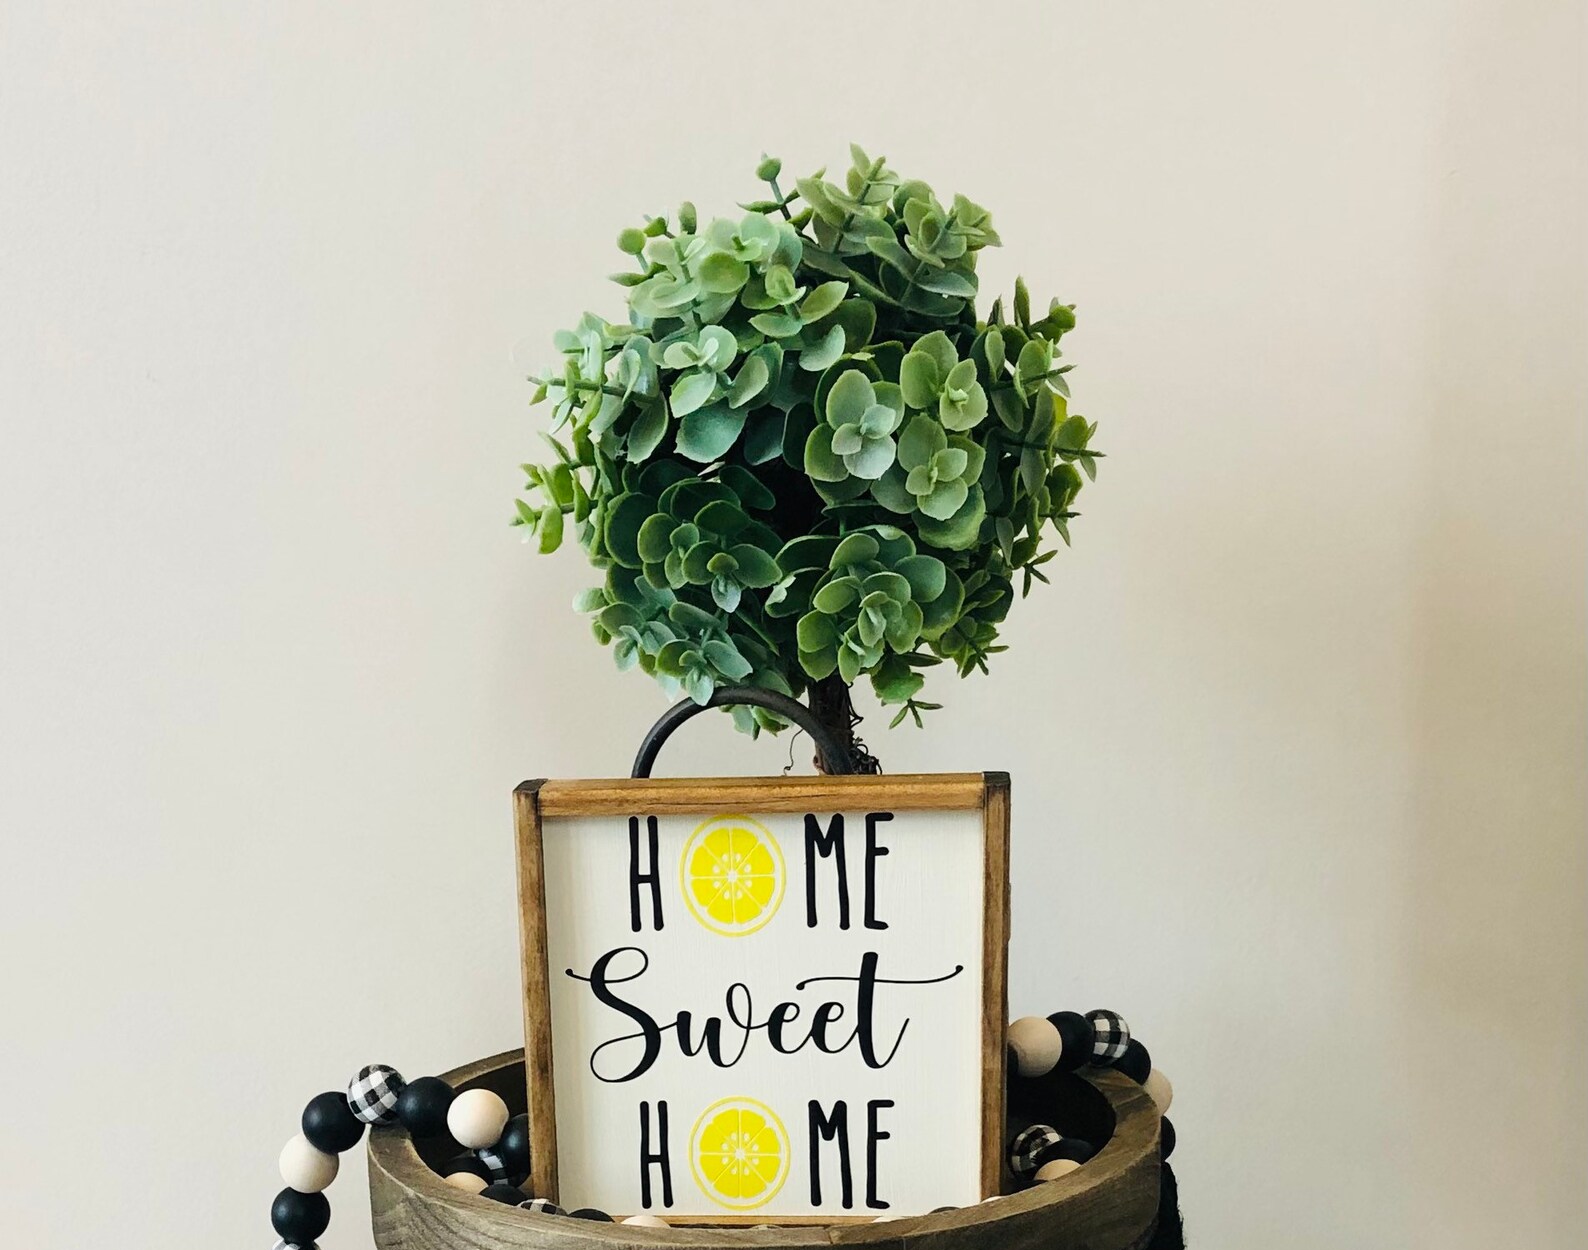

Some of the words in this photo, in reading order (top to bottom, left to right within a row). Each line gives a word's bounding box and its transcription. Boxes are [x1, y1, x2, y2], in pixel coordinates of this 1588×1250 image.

[629, 812, 894, 937] HOME
[564, 946, 964, 1083] Sweet
[640, 1095, 895, 1210] HOME
